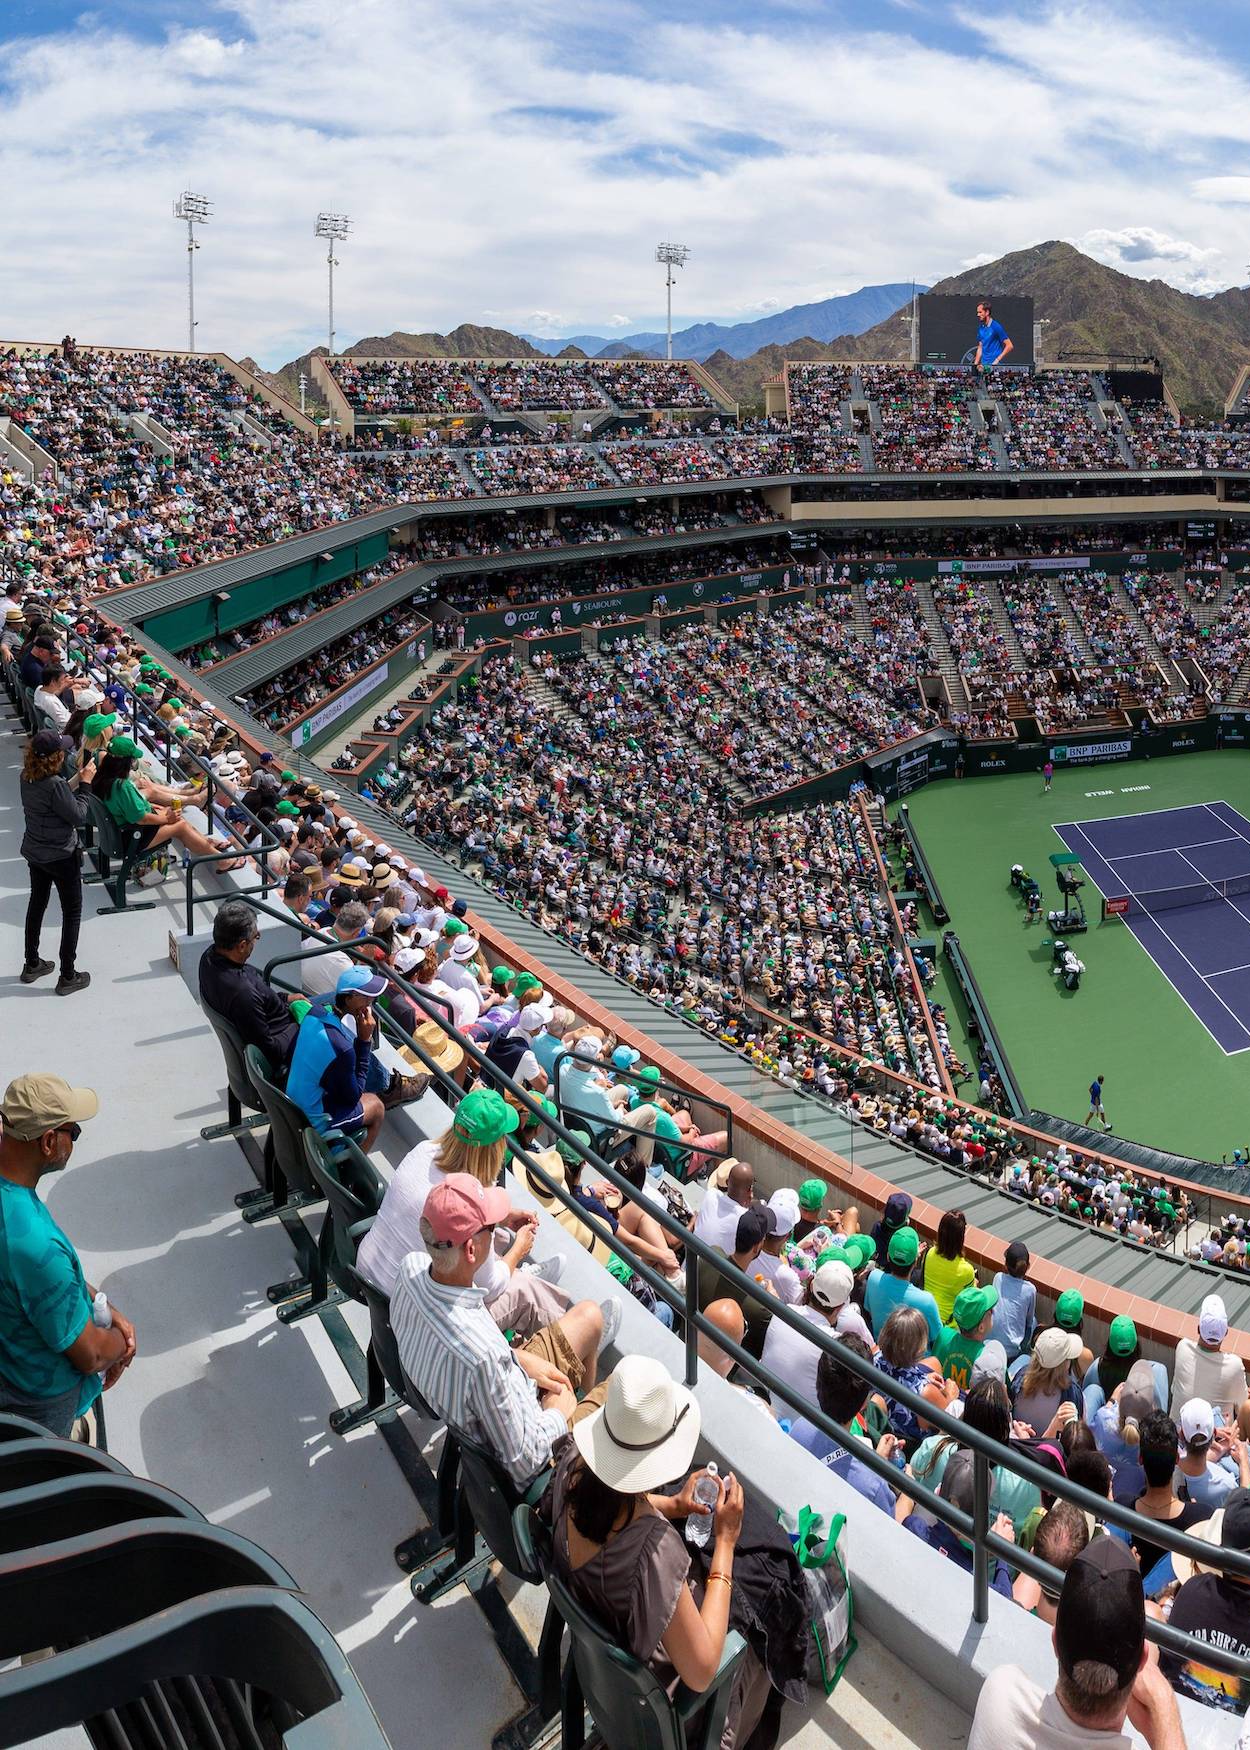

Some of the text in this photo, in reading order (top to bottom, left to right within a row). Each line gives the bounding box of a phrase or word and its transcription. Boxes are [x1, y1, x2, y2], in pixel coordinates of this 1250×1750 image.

[583, 599, 622, 611] SEABOURN
[518, 610, 540, 622] razr
[322, 701, 342, 721] PARIBAS
[1172, 738, 1195, 747] ROLEX
[1069, 743, 1128, 756] BNP PARIBAS
[981, 759, 1006, 767] ROLEX
[1210, 1629, 1238, 1650] SURF
